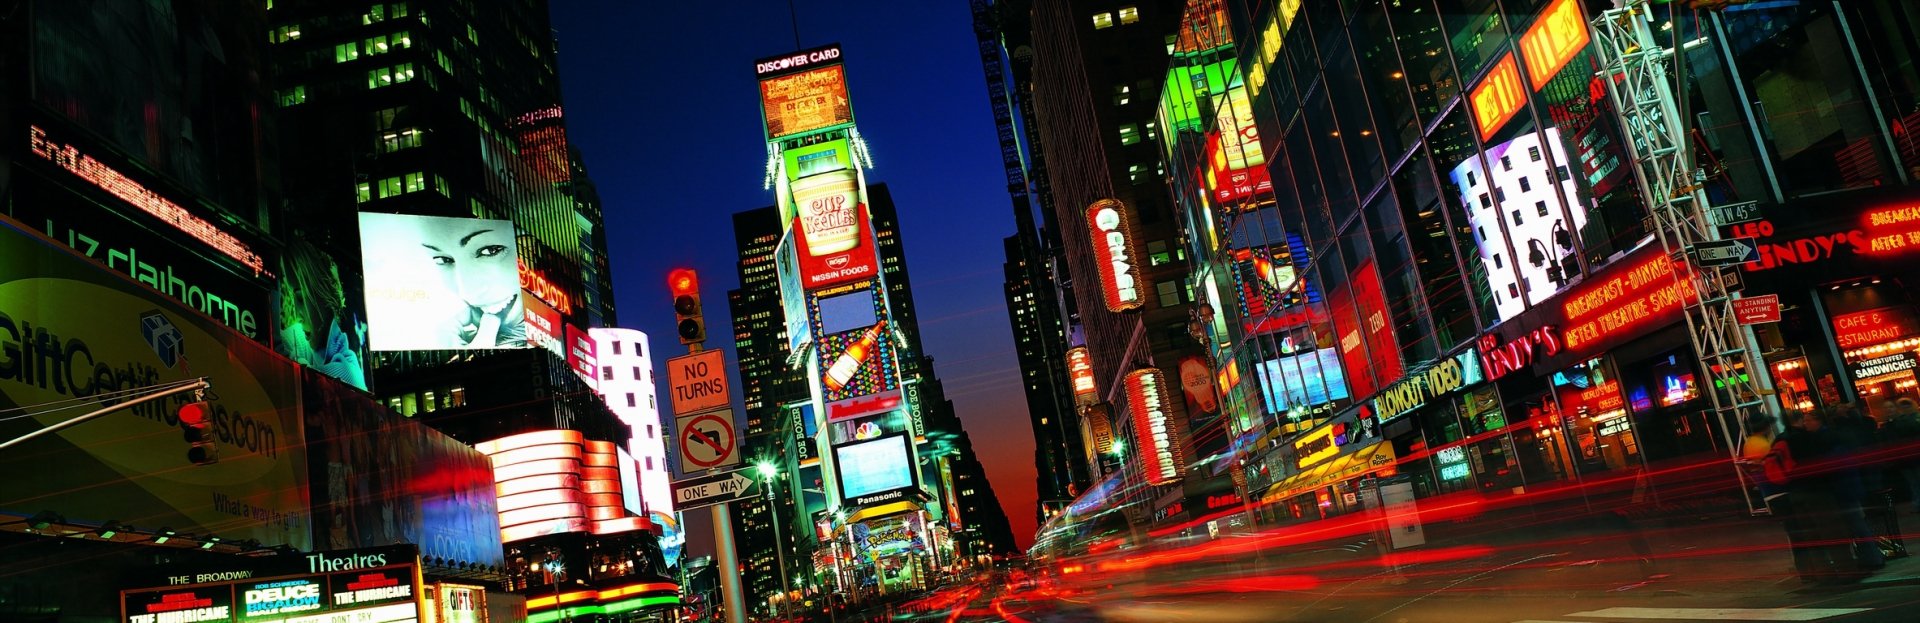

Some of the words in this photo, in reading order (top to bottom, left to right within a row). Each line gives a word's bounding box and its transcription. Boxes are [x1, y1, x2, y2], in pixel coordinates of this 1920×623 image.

[757, 55, 808, 74] DISCOVER
[810, 48, 840, 63] CARD
[809, 194, 845, 216] CUP
[1724, 207, 1735, 222] W
[1736, 205, 1748, 220] 45
[1749, 203, 1757, 212] ST
[1731, 220, 1774, 239] LEO
[1871, 234, 1905, 251] AFTER
[1700, 249, 1715, 259] ONE
[1726, 246, 1744, 257] WAY
[811, 271, 839, 283] NISSIN
[841, 265, 869, 277] FOODS
[530, 271, 571, 316] TOYOTA
[854, 280, 871, 291] 2000
[1740, 306, 1771, 315] ANYTIME
[1744, 298, 1776, 307] STANDING
[1369, 310, 1385, 334] ZERO
[1566, 321, 1599, 348] AFTER
[1597, 298, 1650, 333] THEATRE
[1839, 315, 1868, 329] CAFE
[684, 361, 708, 380] NO
[1855, 359, 1917, 378] SANDWICHES
[1860, 354, 1904, 368] OVERSTUFFED
[676, 378, 723, 401] TURNS
[908, 385, 918, 404] JOE
[1376, 376, 1425, 420] BLOWOUT
[1424, 358, 1461, 398] VIDEO
[792, 407, 805, 440] BOXER
[911, 404, 924, 436] BOXER
[798, 440, 808, 459] JOE
[684, 488, 709, 501] ONE
[719, 478, 745, 494] WAY
[857, 491, 902, 505] Panasonic
[213, 490, 240, 516] What
[243, 503, 250, 517] a
[252, 505, 271, 527] way
[430, 534, 472, 562] JOCKEY
[307, 552, 387, 575] Theatres
[168, 575, 190, 585] THE
[197, 570, 253, 583] BROADWAY
[245, 584, 320, 604] DEUCE
[246, 595, 320, 612] BIGALOW
[334, 592, 355, 605] THE
[356, 585, 411, 602] HURRICANE
[450, 588, 474, 611] GIFTS
[130, 614, 155, 623] THE
